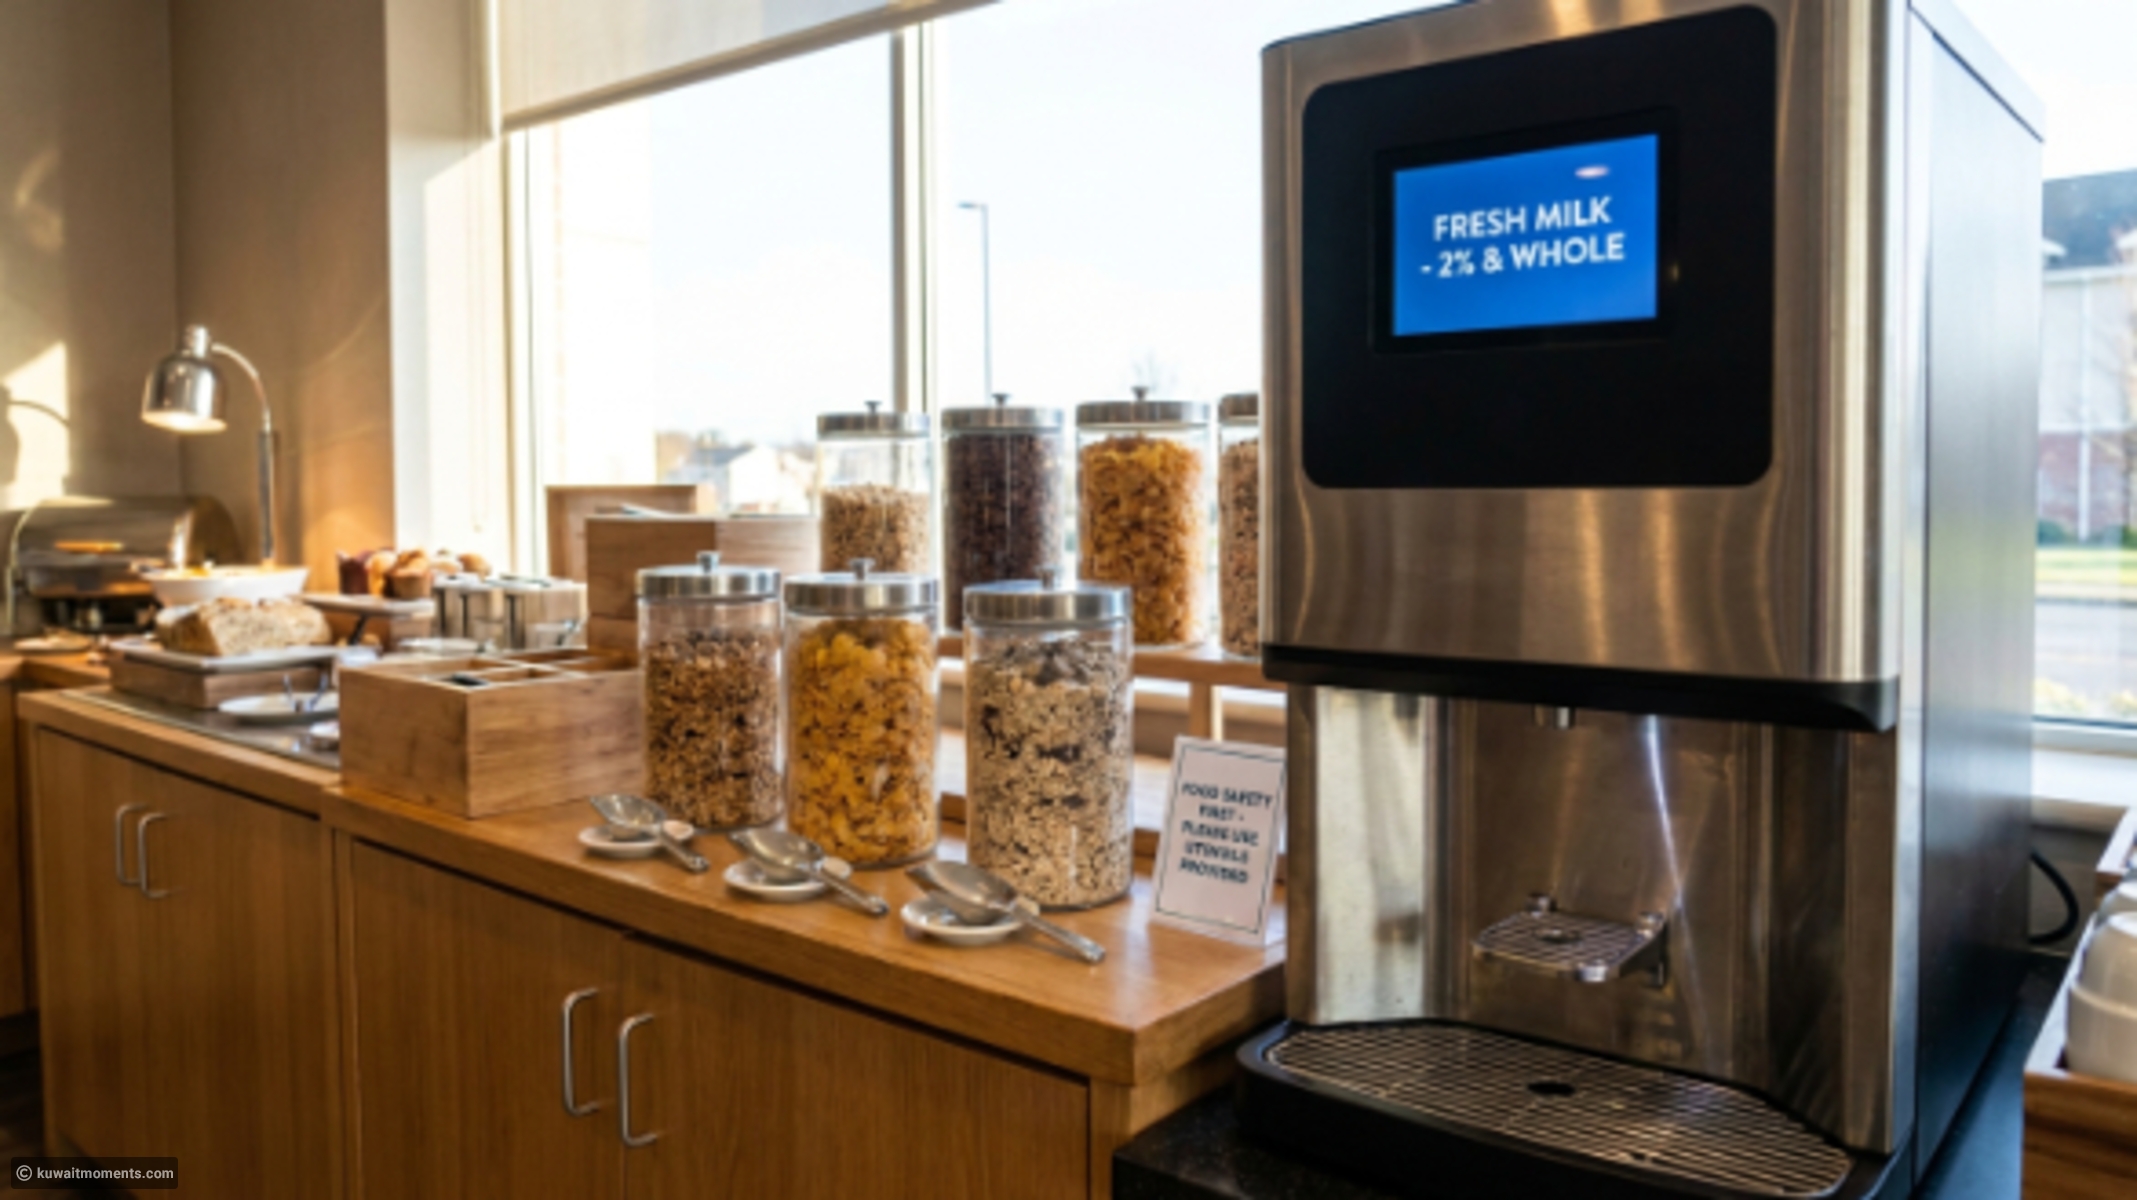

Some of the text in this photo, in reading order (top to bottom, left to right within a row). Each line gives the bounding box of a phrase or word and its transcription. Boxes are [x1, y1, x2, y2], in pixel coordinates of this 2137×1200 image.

[1434, 196, 1612, 241] FRESH MILK
[1438, 249, 1475, 278] 2%
[1482, 246, 1503, 274] &
[1509, 232, 1625, 270] WHOLE
[1181, 782, 1273, 809] FOOD SAFETY
[1198, 804, 1235, 821] FIRST
[1181, 820, 1229, 840] PLEASE
